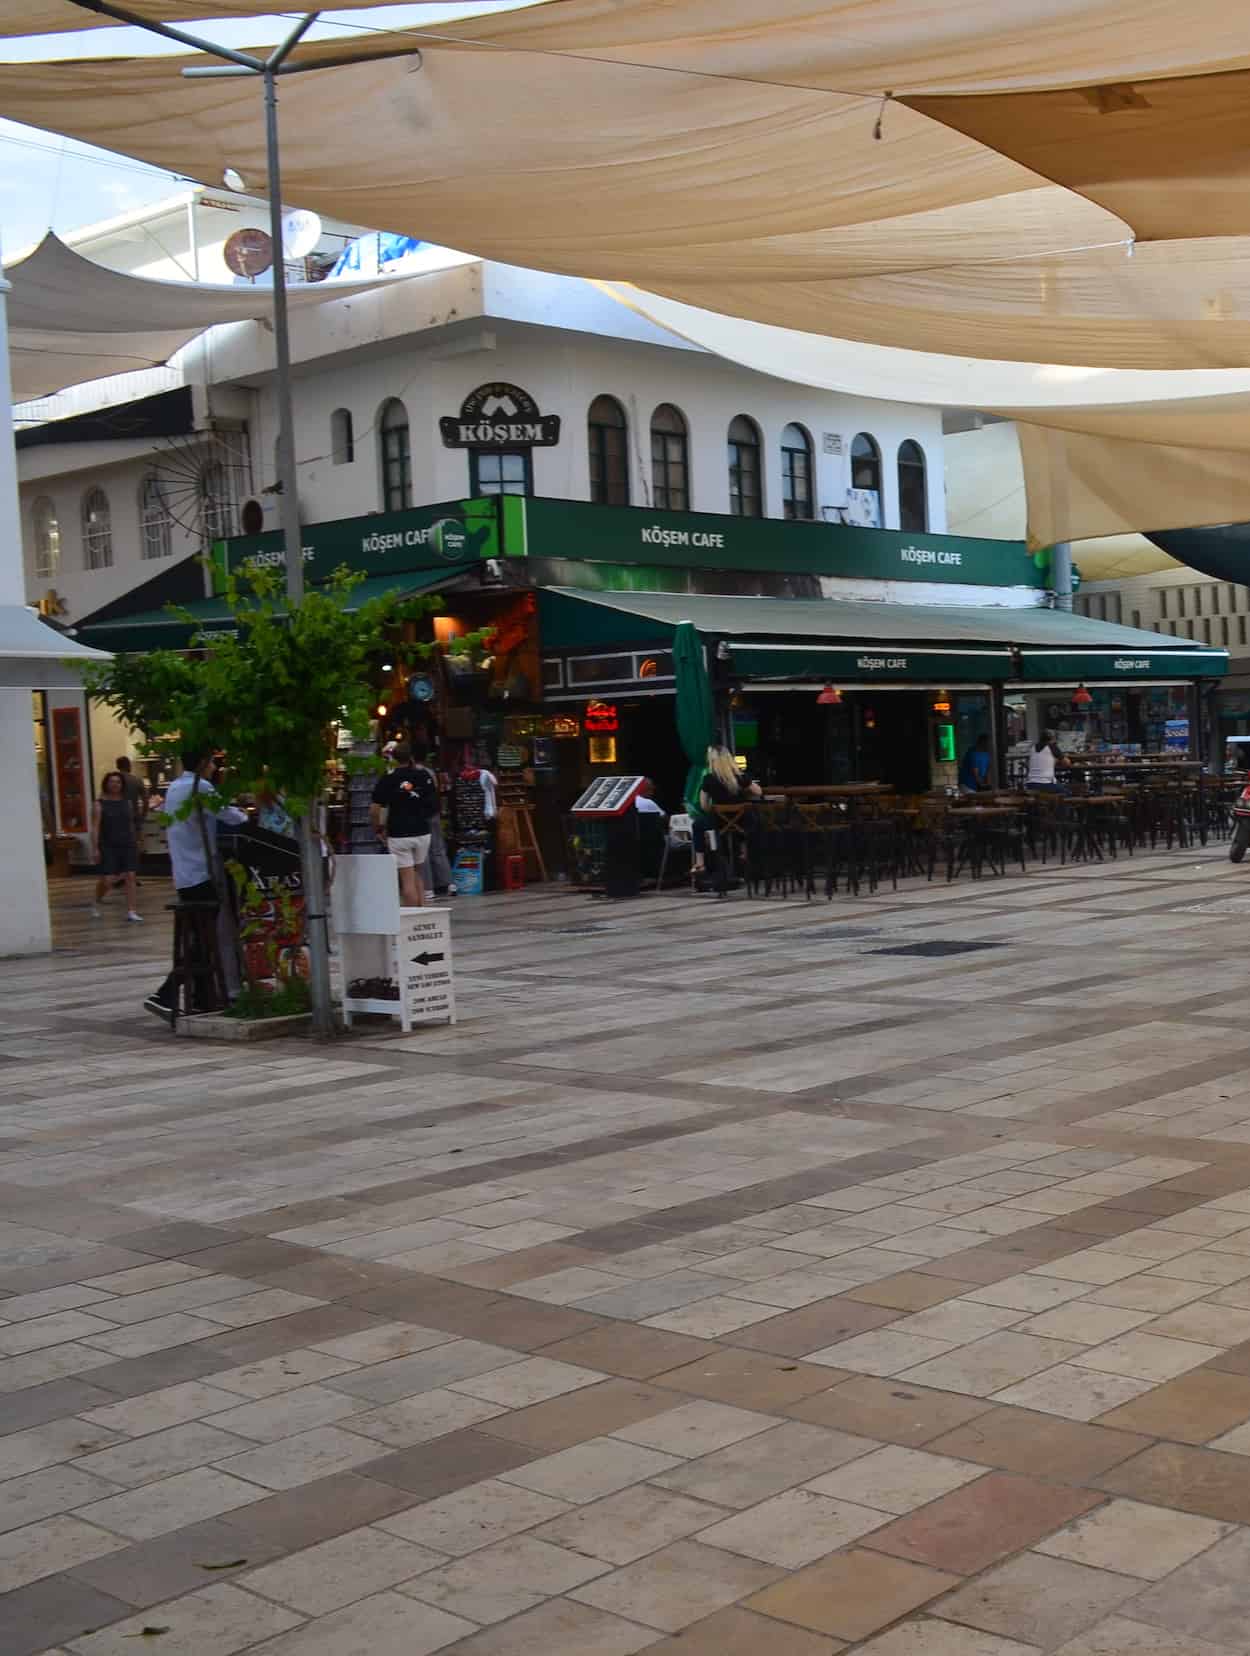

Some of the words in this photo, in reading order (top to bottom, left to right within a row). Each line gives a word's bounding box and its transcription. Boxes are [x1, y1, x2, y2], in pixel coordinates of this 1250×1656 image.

[459, 420, 543, 444] KÖŞEM
[362, 532, 403, 553] KÖŞEM
[405, 528, 434, 546] CAF
[641, 525, 689, 548] KÖŞEM
[692, 532, 725, 548] CAFE
[901, 546, 936, 565] KÖŞEM
[937, 552, 962, 565] CAFE
